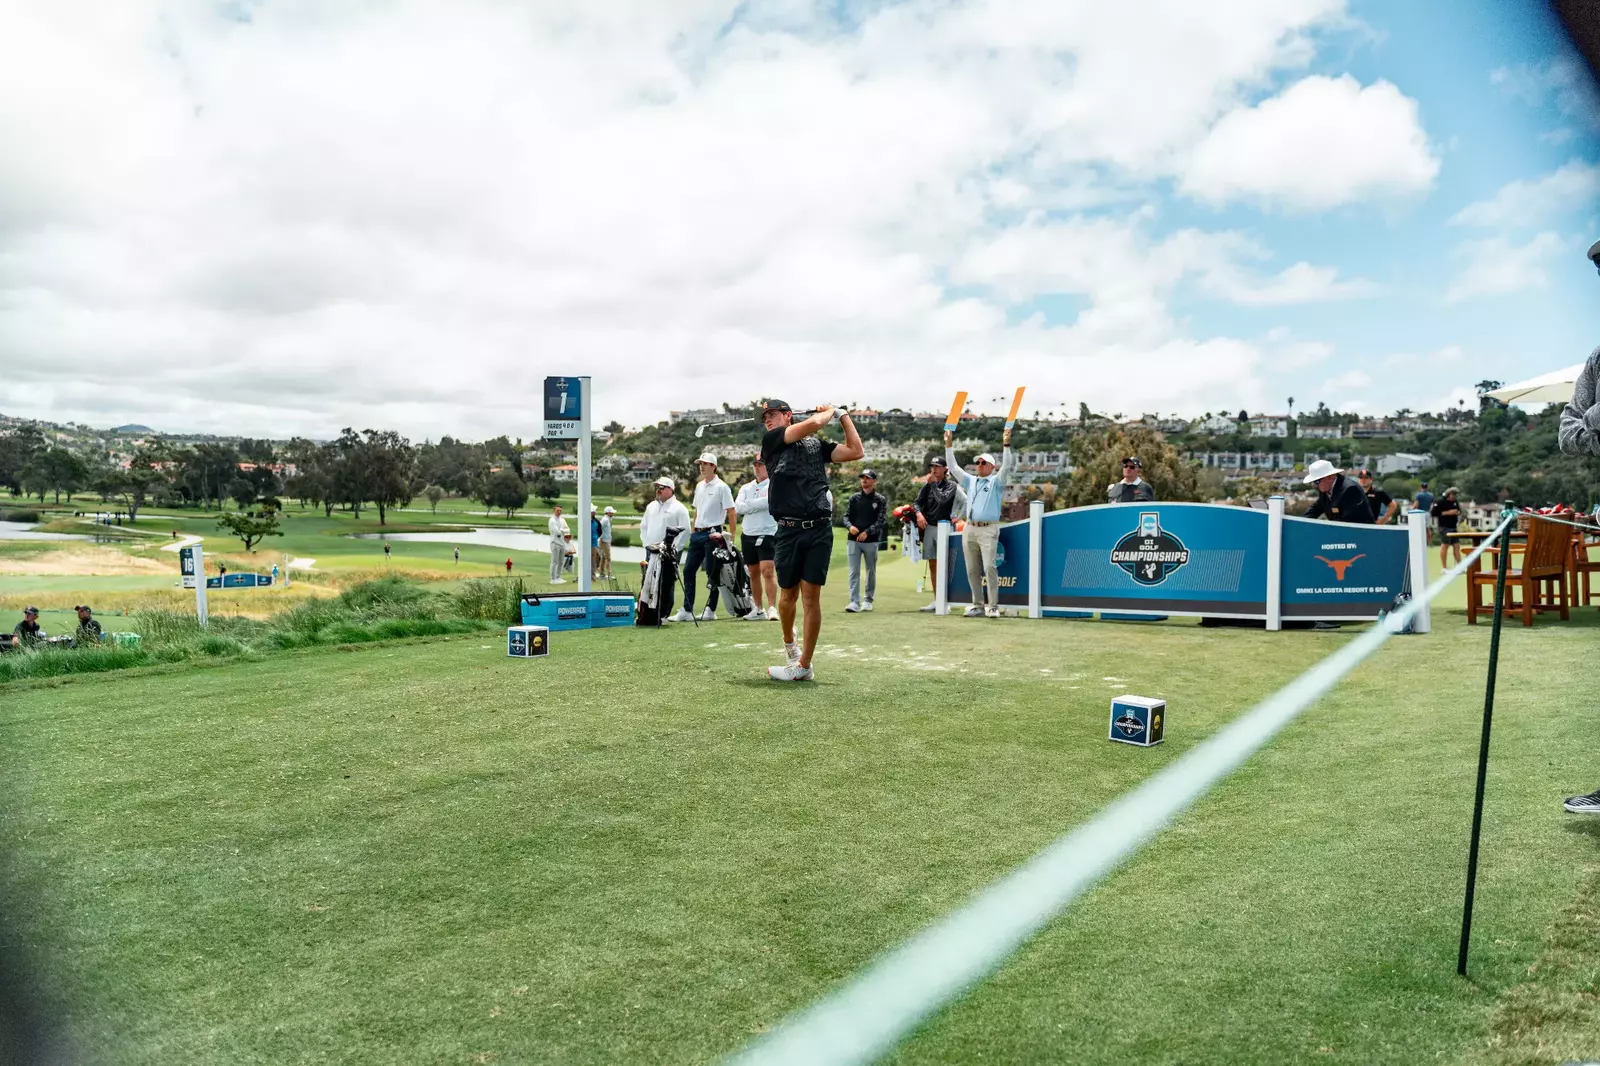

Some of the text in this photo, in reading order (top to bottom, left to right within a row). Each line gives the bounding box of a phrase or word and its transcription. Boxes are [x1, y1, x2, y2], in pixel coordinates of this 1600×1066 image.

[1112, 551, 1188, 562] CHAMPIONSHIPS
[184, 558, 194, 572] 16
[557, 606, 587, 615] POWERADE
[605, 604, 630, 612] POWERADE
